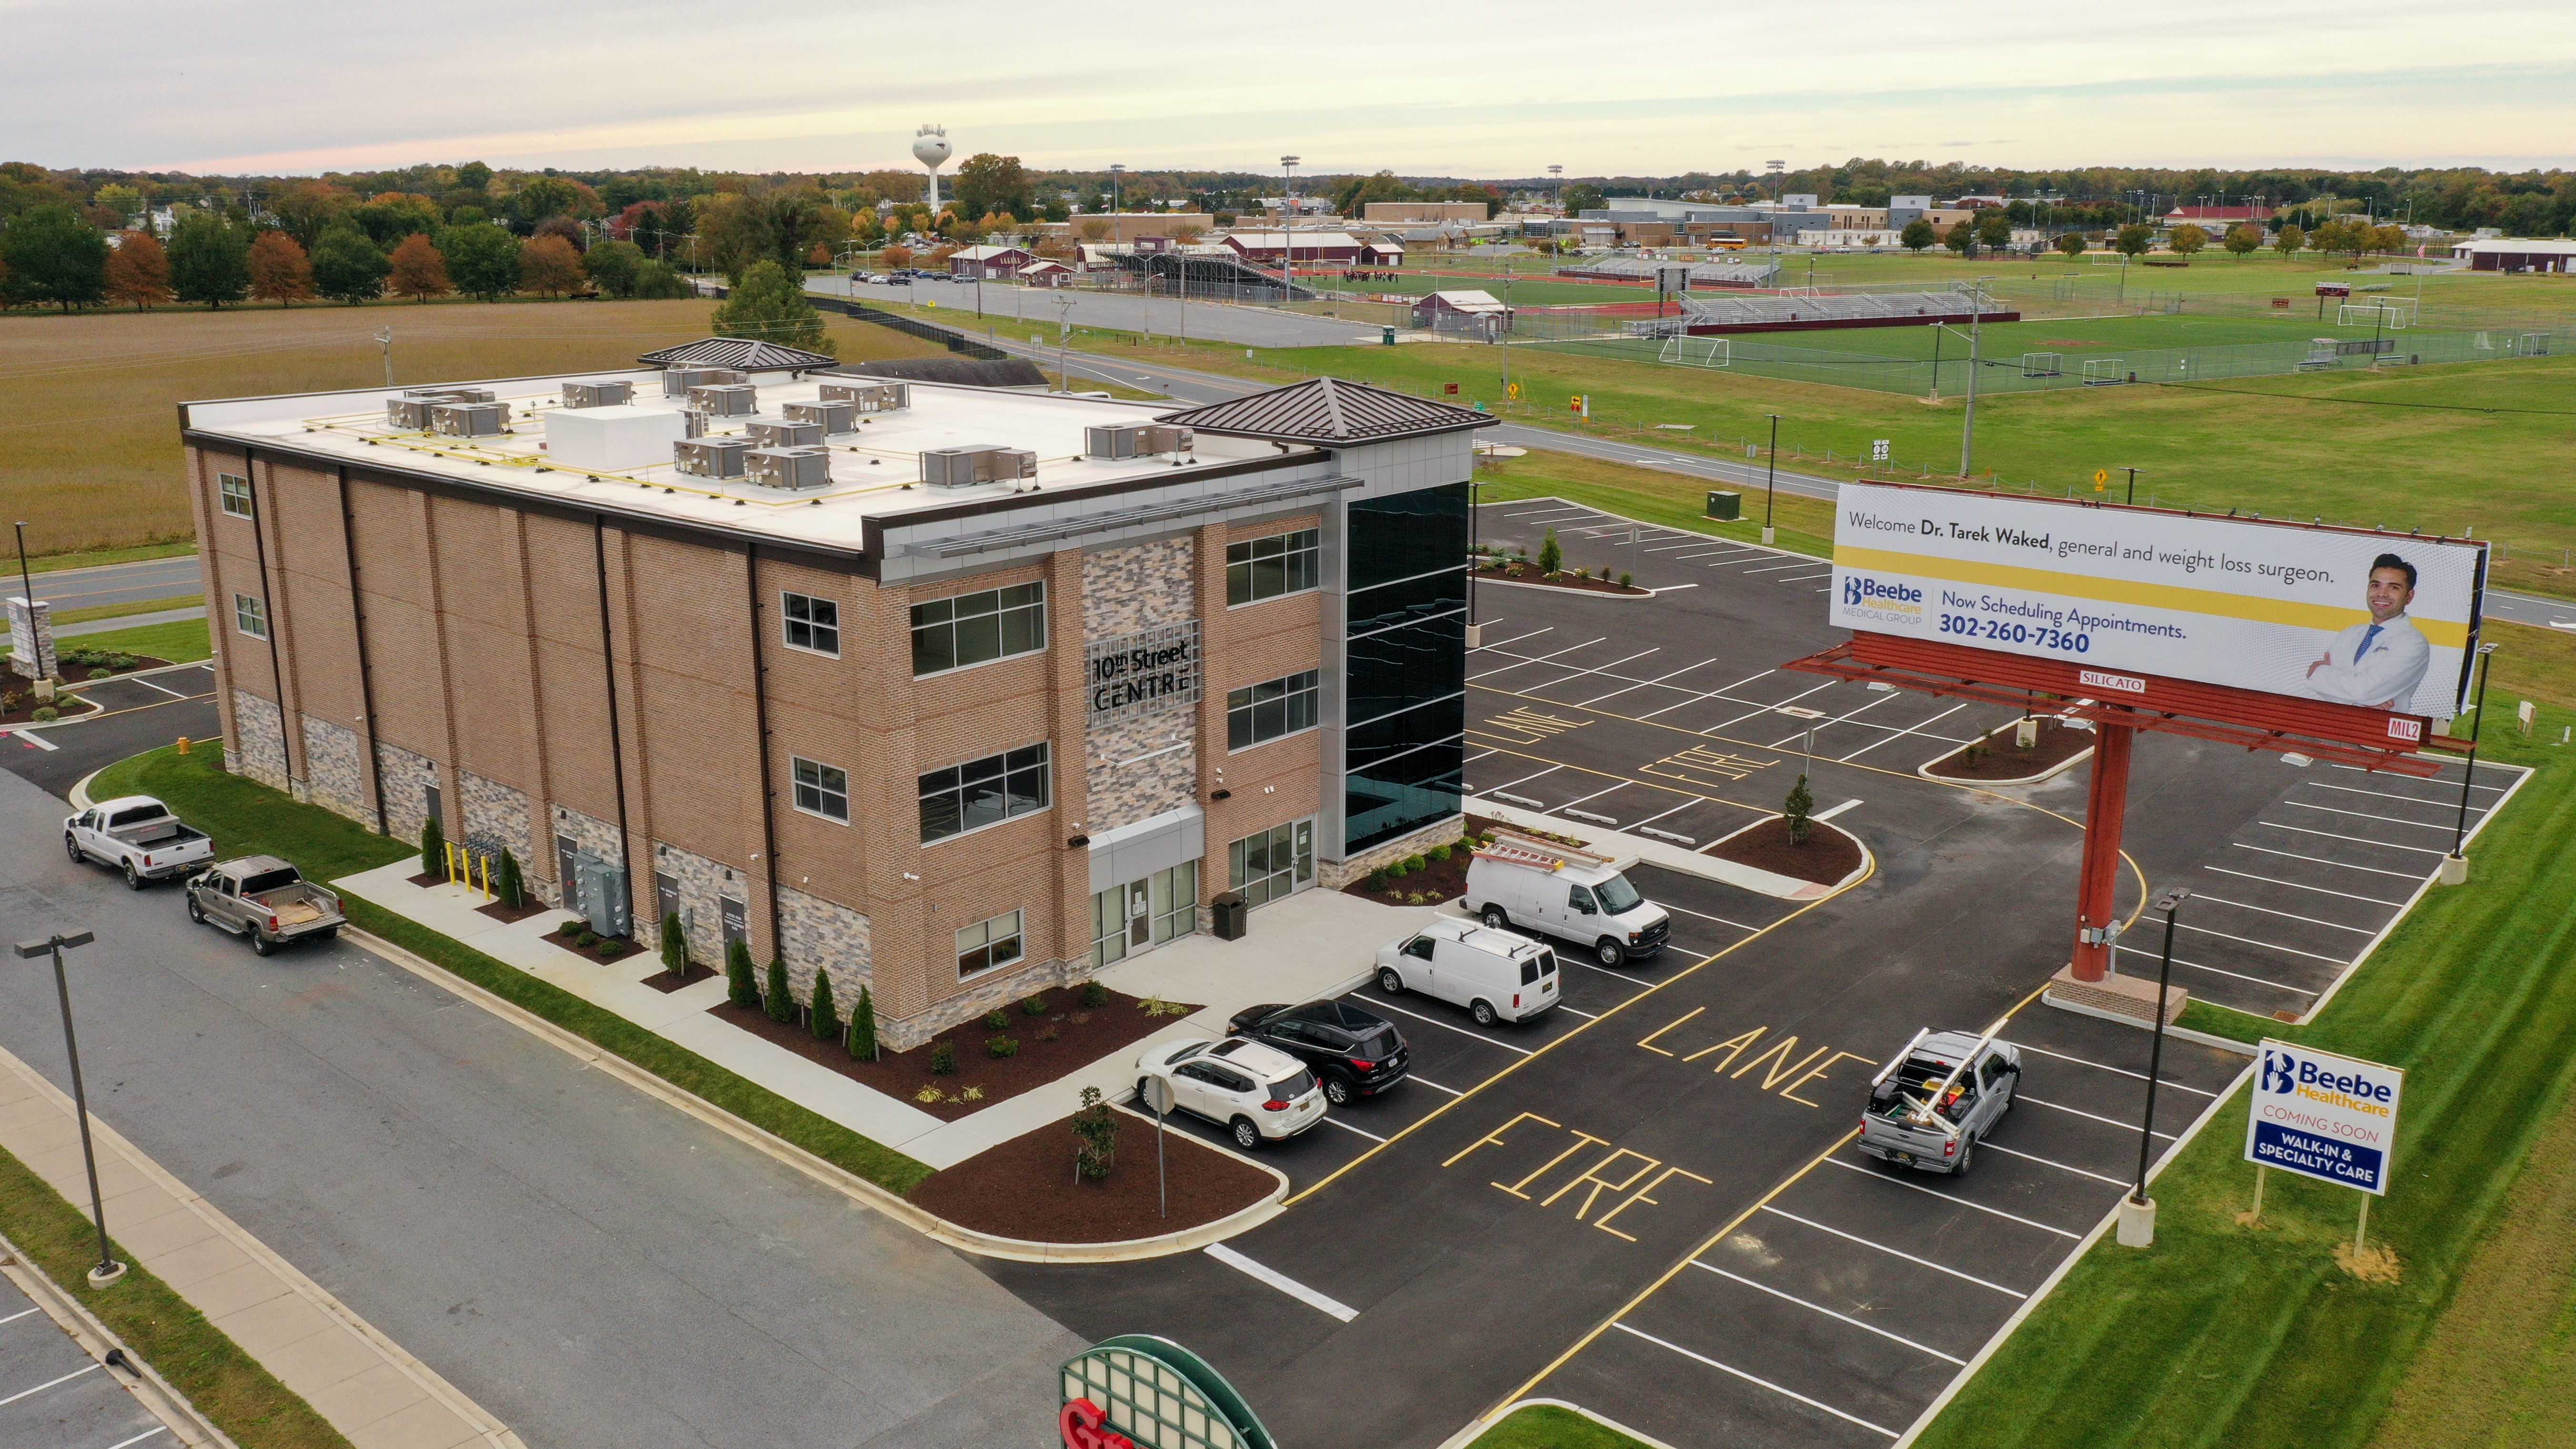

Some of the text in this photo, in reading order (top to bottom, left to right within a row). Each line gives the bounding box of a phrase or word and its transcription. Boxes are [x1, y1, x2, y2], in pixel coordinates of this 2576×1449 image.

[1849, 511, 2334, 584] Welcome Dr. Tarek Waked, general and weight loss surgeon.
[1862, 597, 1922, 615] Healthcare
[1864, 578, 1922, 603] Beebe
[1843, 607, 1922, 625] MEDICAL GROUP
[1939, 613, 2090, 653] 302-260-7360
[1942, 590, 2186, 639] Now Scheduling Appointments.
[1093, 640, 1188, 681] 10th Street
[1094, 668, 1189, 711] CENTRE
[2083, 672, 2142, 690] SILICATO
[2389, 720, 2418, 738] MIL2
[1638, 744, 1781, 788] FIRE
[1636, 1006, 1878, 1107] LANE
[2296, 1083, 2389, 1118] Healthcare
[2299, 1060, 2391, 1103] Beebe
[2263, 1104, 2379, 1143] COMING SOON
[2258, 1143, 2374, 1183] SPECIALTY CARE
[2281, 1132, 2352, 1162] WALK-IN &
[1441, 1112, 1713, 1242] FIRE
